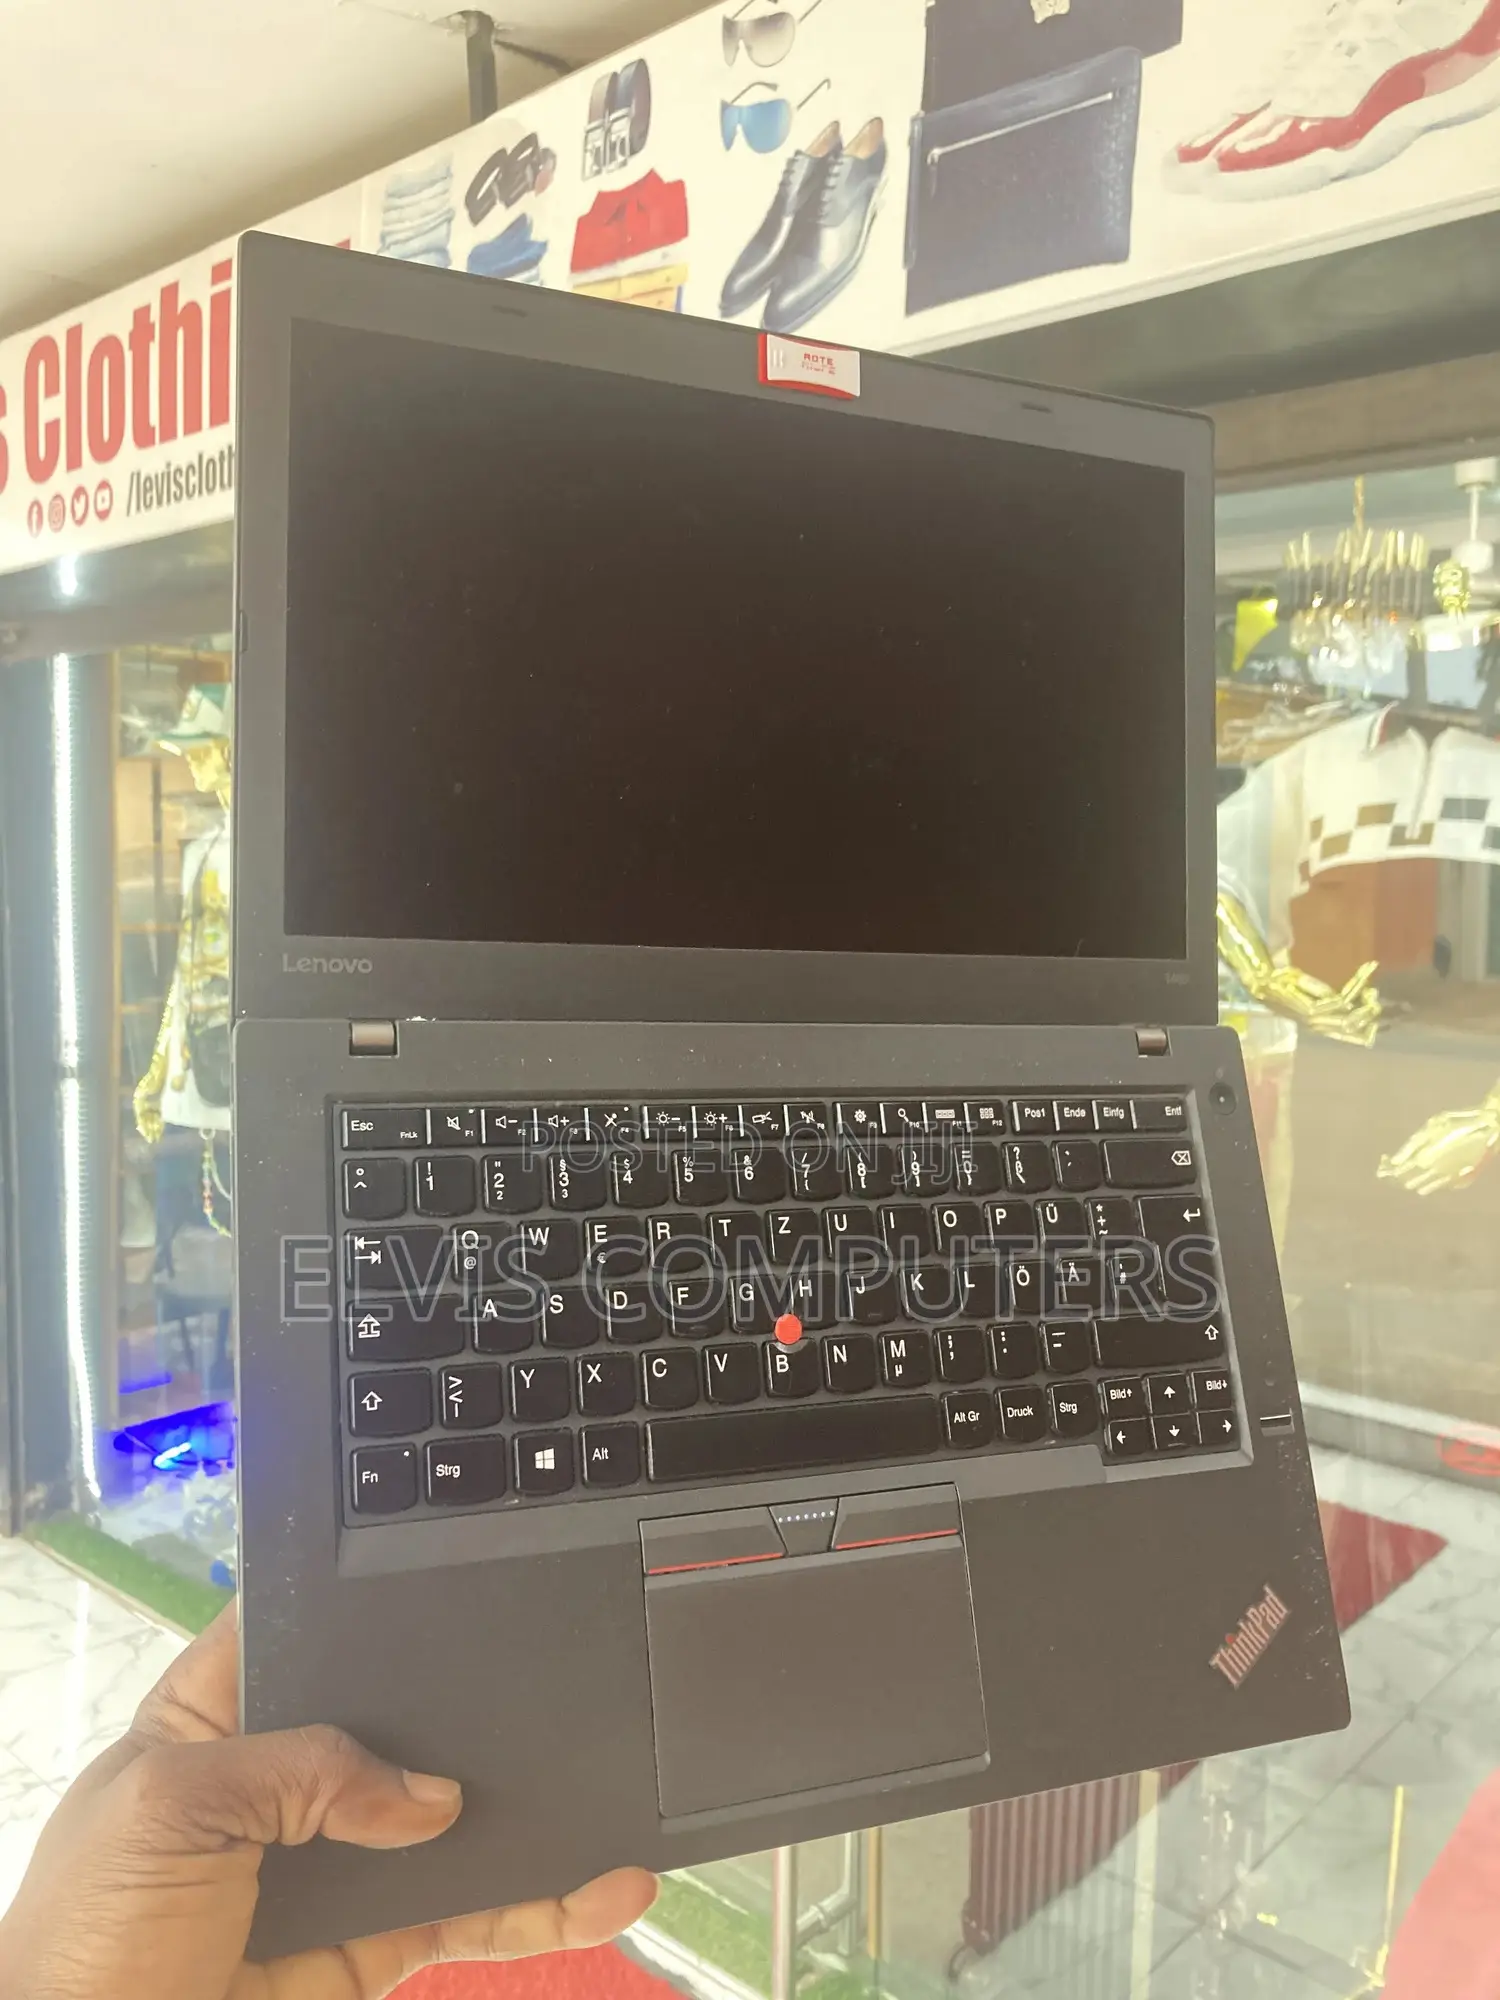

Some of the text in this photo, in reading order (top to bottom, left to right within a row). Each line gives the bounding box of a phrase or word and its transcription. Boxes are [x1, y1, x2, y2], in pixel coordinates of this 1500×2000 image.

[282, 953, 373, 973] Lenovo
[1024, 1107, 1046, 1118] Pos1
[1063, 1107, 1086, 1118] Ende
[1103, 1106, 1125, 1120] Einfg
[351, 1120, 374, 1131] Esc
[517, 1128, 527, 1136] F2
[771, 1123, 779, 1131] F7
[622, 1169, 633, 1184] 4
[683, 1168, 694, 1183] 5
[744, 1166, 754, 1181] 6
[801, 1164, 811, 1179] 7
[857, 1162, 867, 1177] 8
[911, 1161, 920, 1176] 9
[425, 1175, 434, 1191] 1
[493, 1172, 505, 1189] 2
[558, 1171, 570, 1187] 3
[496, 1190, 504, 1201] 2
[561, 1188, 569, 1199] 3
[943, 1210, 957, 1227] O
[995, 1208, 1007, 1225] P
[1045, 1204, 1059, 1224] Ü
[656, 1221, 671, 1240] R
[718, 1219, 731, 1237] T
[777, 1216, 791, 1235] Z
[834, 1214, 848, 1232] U
[461, 1229, 479, 1250] Q
[528, 1227, 550, 1246] W
[594, 1224, 607, 1244] E
[464, 1256, 476, 1270] @
[597, 1253, 607, 1264] €
[964, 1270, 976, 1288] L
[1016, 1265, 1030, 1286] Ö
[1068, 1262, 1080, 1282] Ä
[799, 1279, 813, 1297] H
[855, 1276, 866, 1294] J
[911, 1273, 924, 1291] K
[613, 1291, 628, 1310] D
[677, 1287, 689, 1305] F
[738, 1283, 754, 1301] G
[482, 1298, 498, 1319] A
[549, 1295, 564, 1314] S
[833, 1345, 848, 1363] N
[890, 1340, 906, 1358] M
[651, 1359, 667, 1378] C
[714, 1354, 729, 1373] V
[776, 1354, 789, 1373] B
[520, 1369, 535, 1389] Y
[586, 1364, 602, 1384] X
[1110, 1387, 1126, 1400] Bild
[1206, 1379, 1223, 1391] Bild
[954, 1410, 980, 1423] Alt Gr
[1007, 1405, 1034, 1418] Druck
[1059, 1402, 1078, 1415] Strg
[592, 1448, 609, 1461] Alt
[362, 1471, 379, 1485] Fn
[436, 1464, 461, 1479] Strg
[1209, 1585, 1288, 1688] ThinkPad
